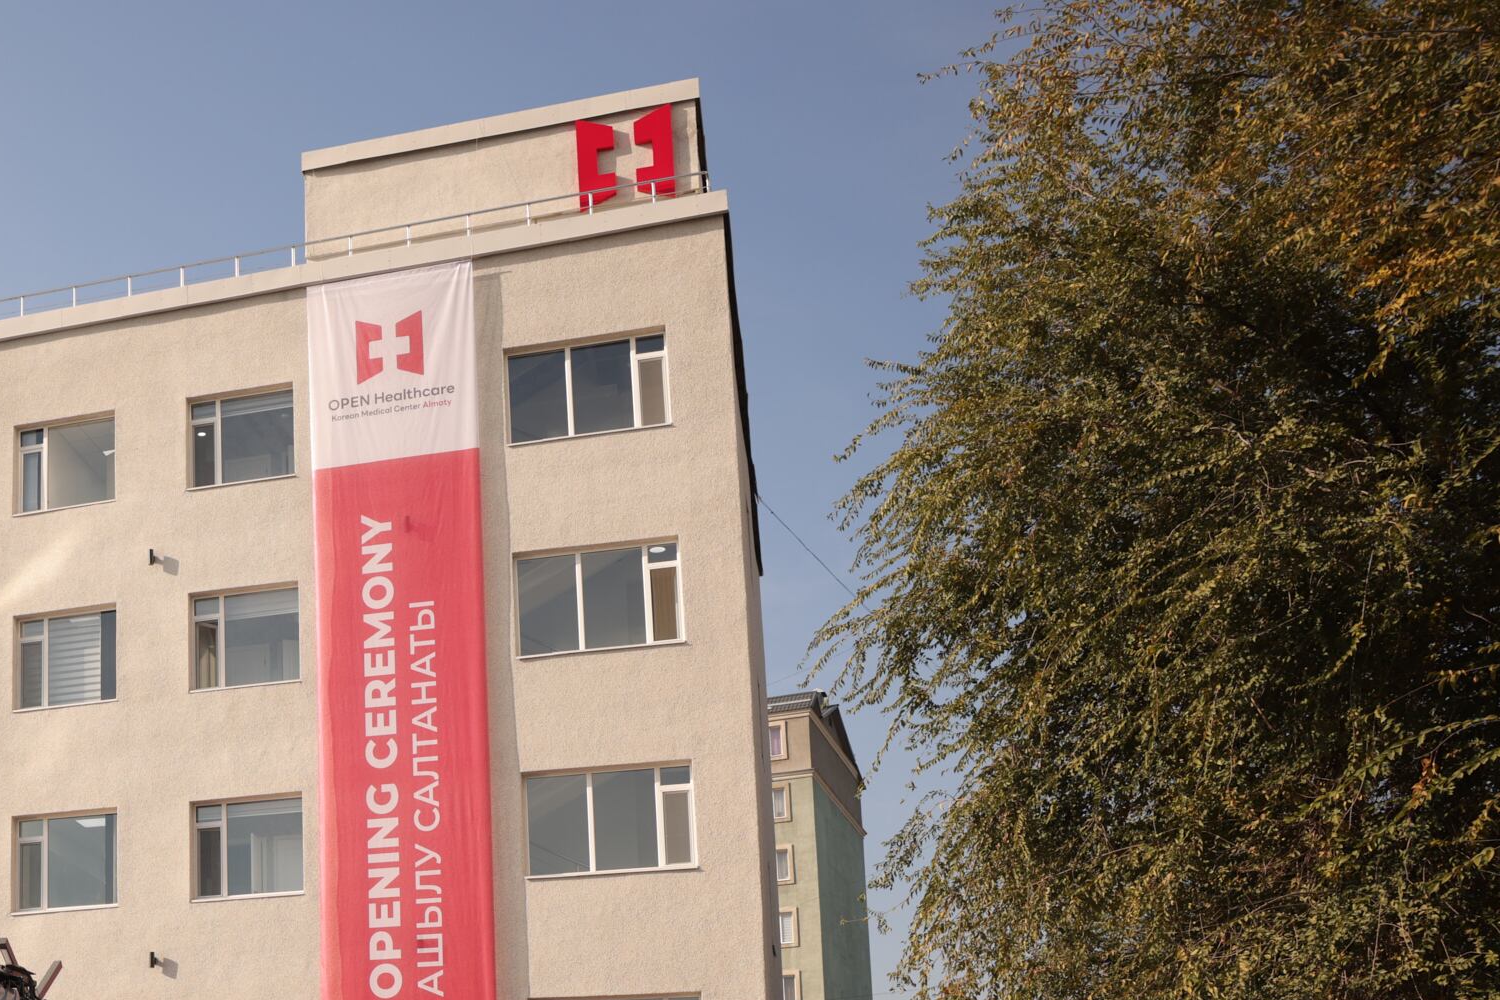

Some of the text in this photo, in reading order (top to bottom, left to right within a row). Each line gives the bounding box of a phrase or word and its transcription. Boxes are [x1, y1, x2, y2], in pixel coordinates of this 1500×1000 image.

[328, 385, 455, 411] OPEN Healthcare
[331, 399, 452, 422] Korean Medical Center Almaty
[360, 515, 403, 999] OPENING CEREMONY
[408, 600, 444, 998] АШЫЛУ САЛТАНАТЫ
